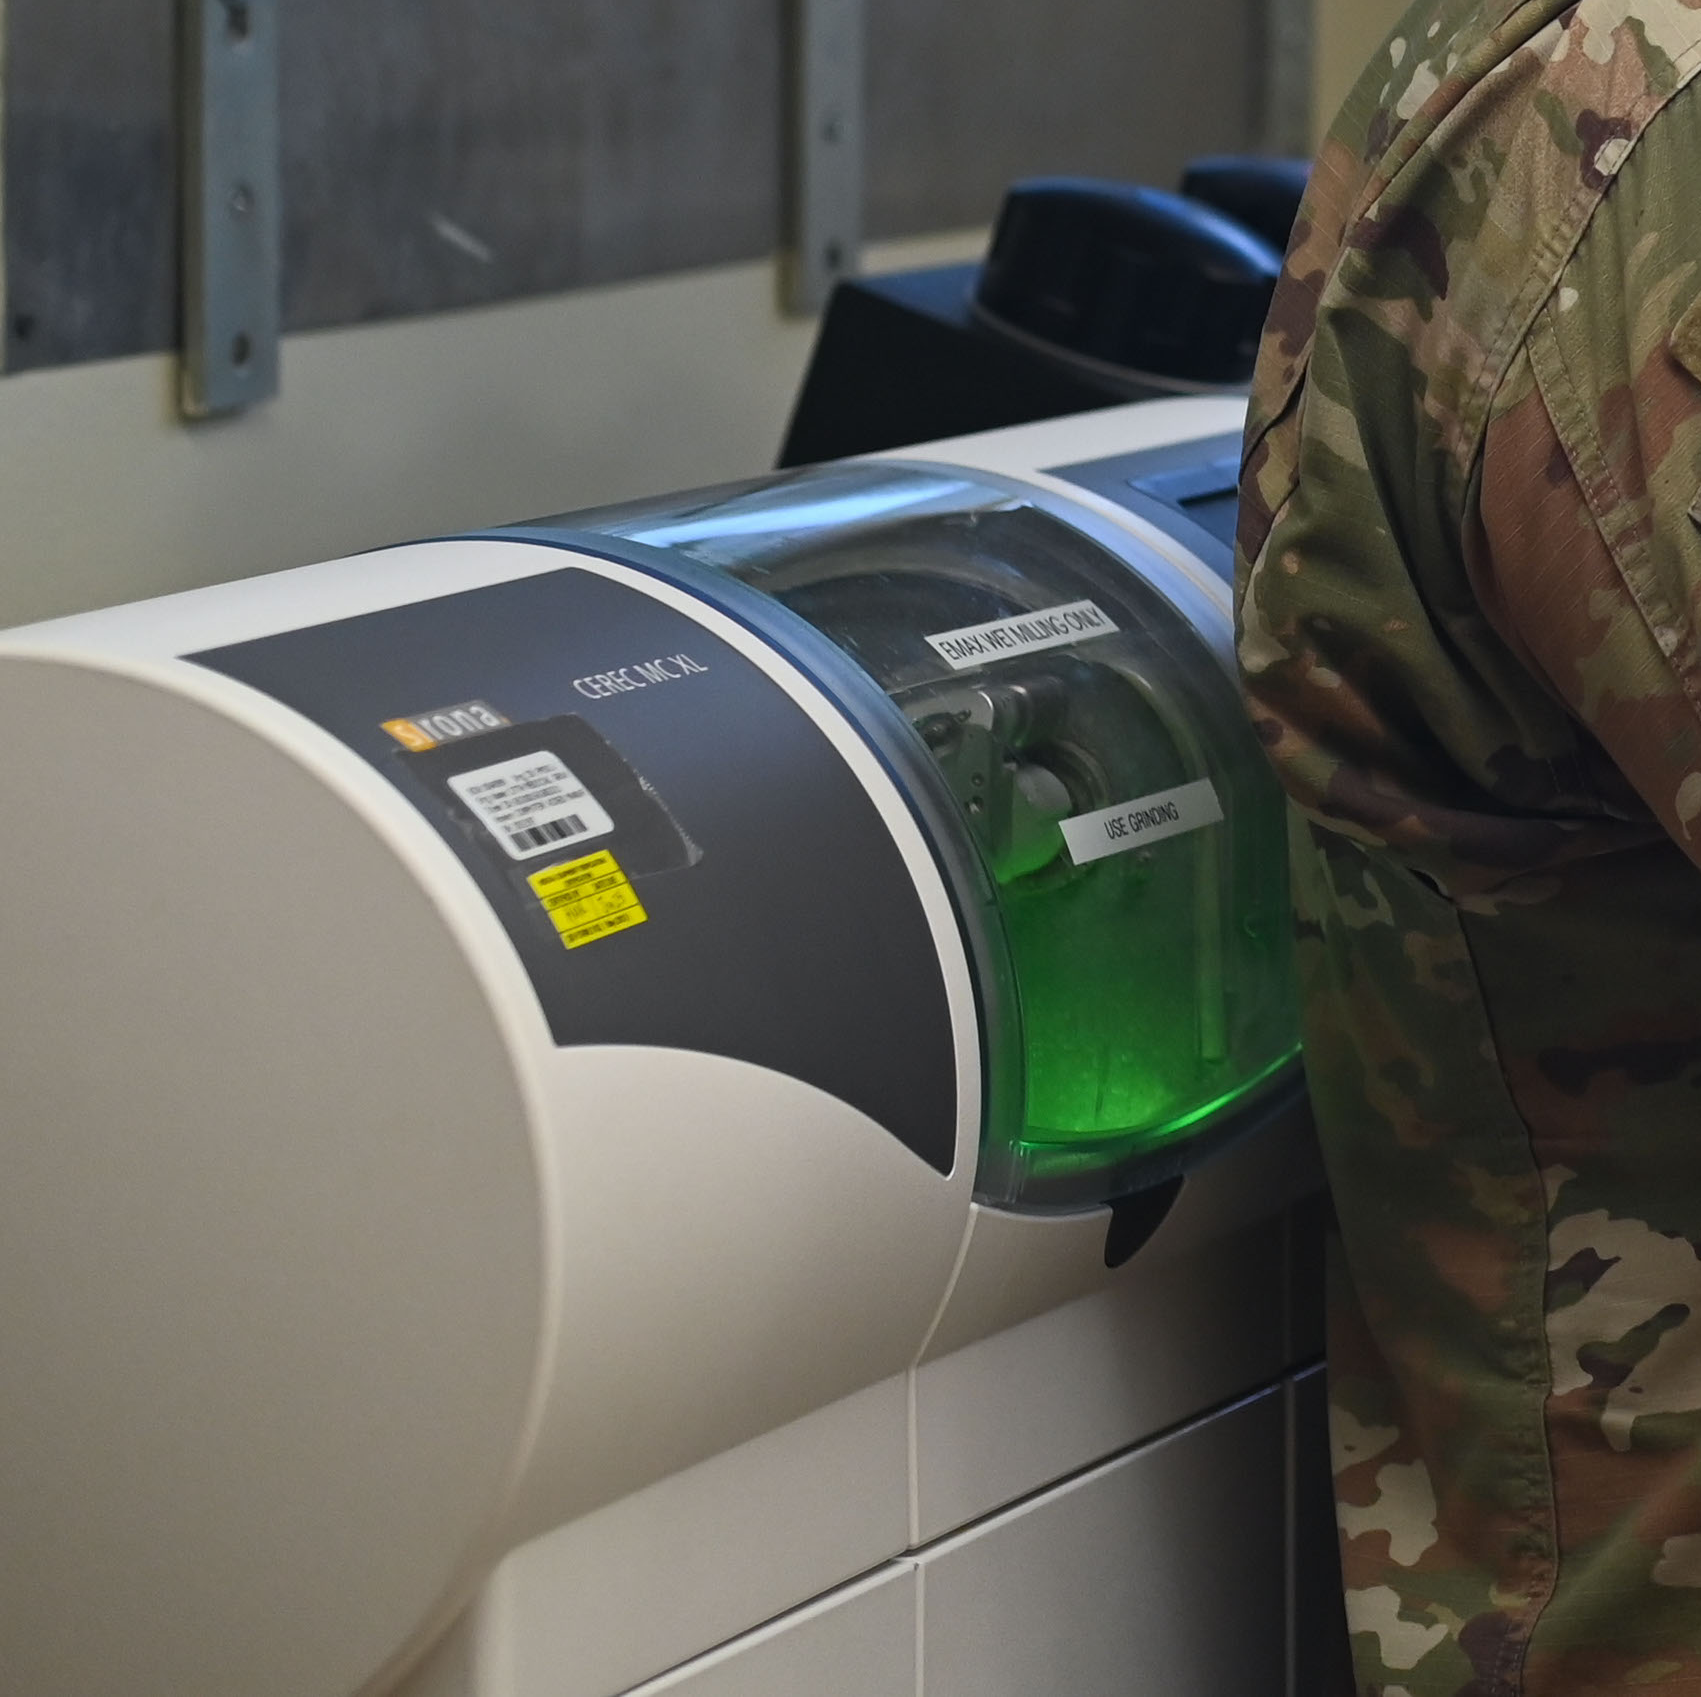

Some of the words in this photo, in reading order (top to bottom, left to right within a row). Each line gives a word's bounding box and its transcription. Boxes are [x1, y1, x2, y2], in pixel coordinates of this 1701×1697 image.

[938, 635, 988, 661] EMAX
[980, 627, 1016, 651] WET
[1007, 613, 1069, 645] MILLING
[1063, 607, 1106, 632] ONLY
[572, 667, 647, 699] CEREC
[632, 659, 682, 684] MC
[666, 653, 709, 675] XL
[1103, 816, 1129, 840] USE
[1128, 801, 1180, 833] GRINDING
